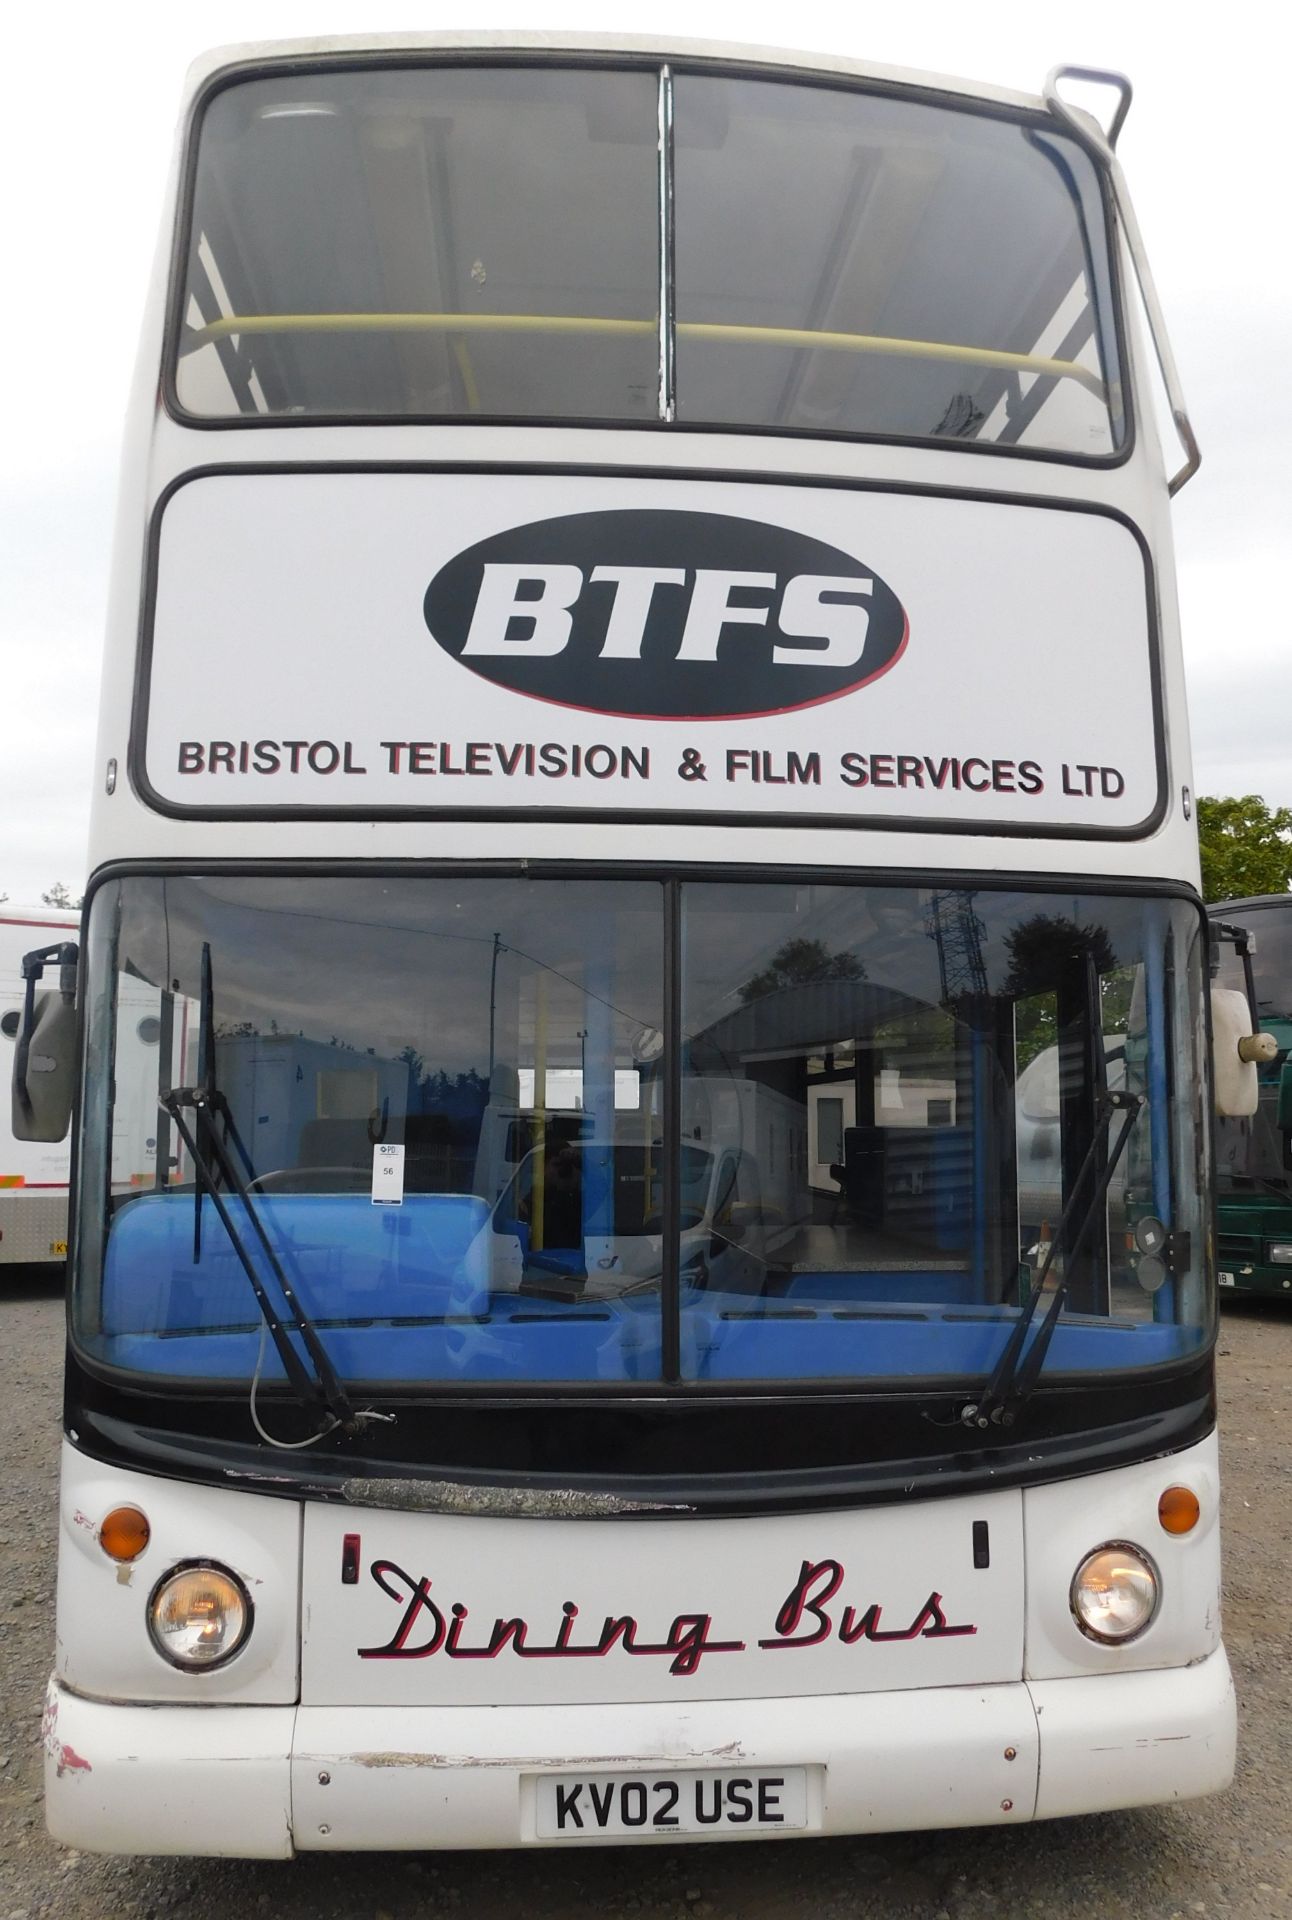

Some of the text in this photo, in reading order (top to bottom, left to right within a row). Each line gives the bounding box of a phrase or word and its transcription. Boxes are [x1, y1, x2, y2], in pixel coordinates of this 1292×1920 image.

[461, 563, 874, 668] BTFS
[178, 740, 1125, 799] BRISTOL TELEVISION & FILM SERVICES LTD
[383, 1167, 394, 1175] 56
[357, 1559, 977, 1677] Dining Bus
[556, 1777, 785, 1829] KV02 USE
